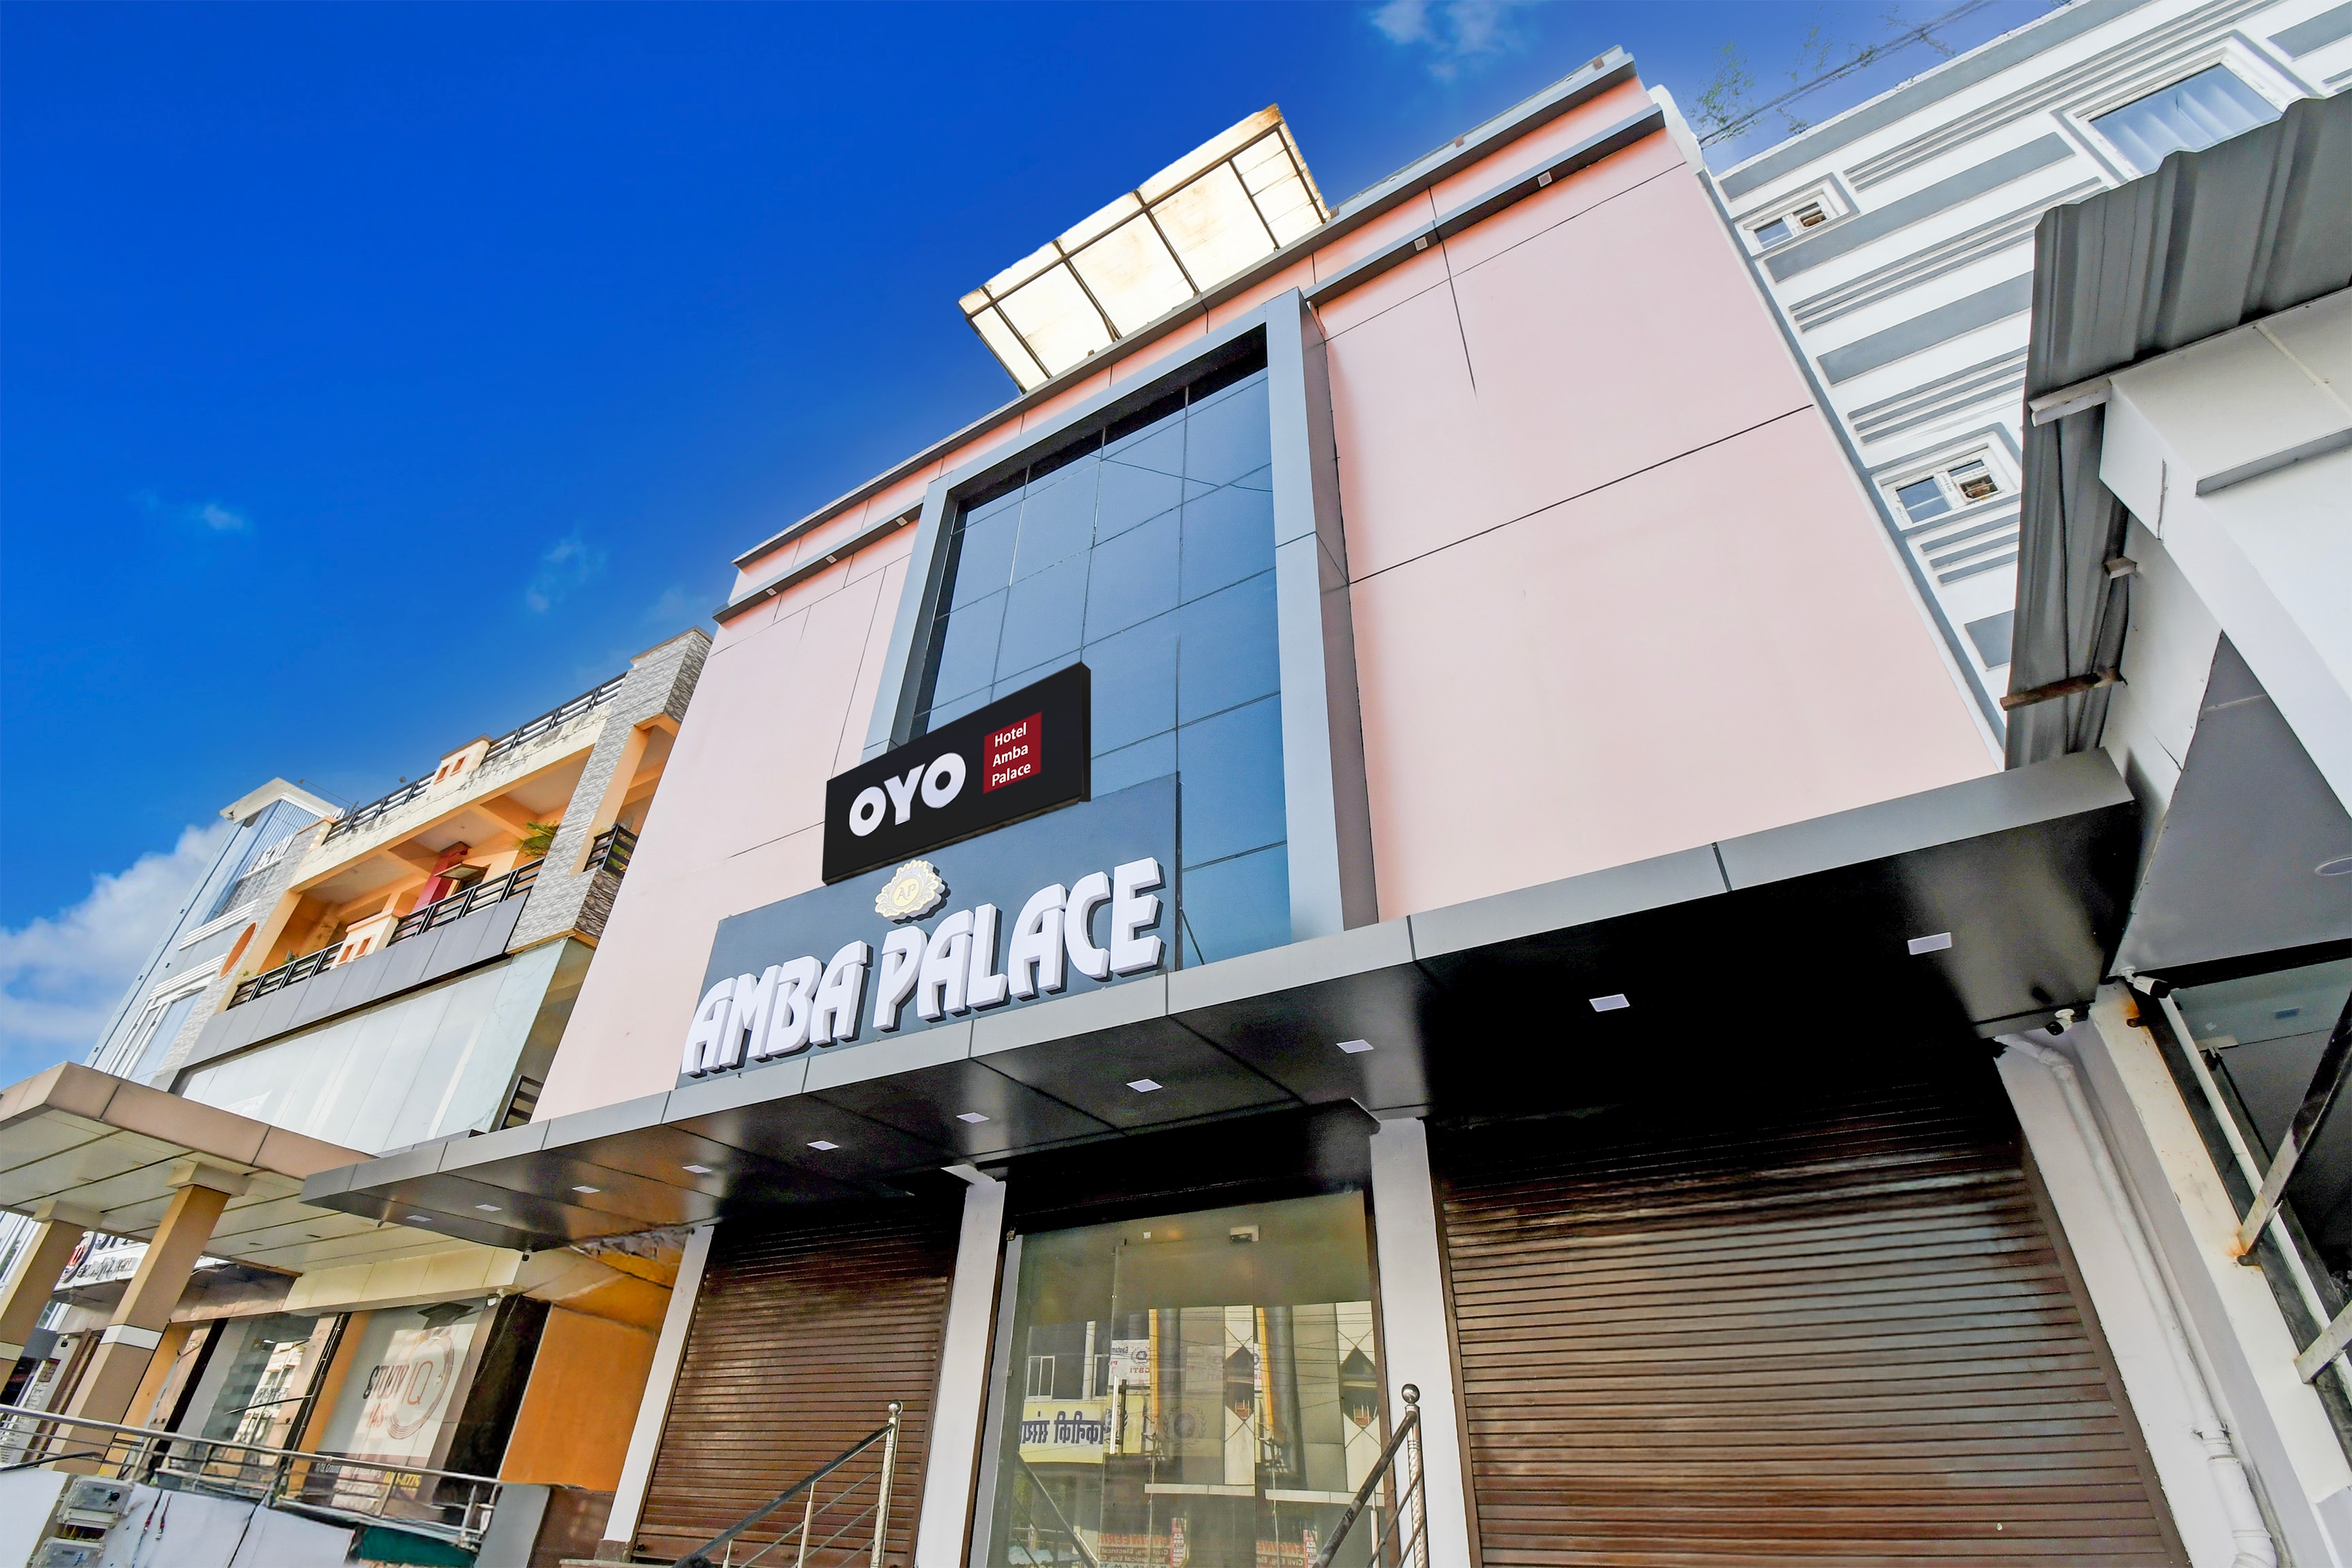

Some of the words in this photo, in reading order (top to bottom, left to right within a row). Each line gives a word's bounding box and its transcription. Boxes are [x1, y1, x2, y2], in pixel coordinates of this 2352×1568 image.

[995, 722, 1026, 747] Hotel
[993, 745, 1028, 767] Amba
[992, 763, 1031, 787] Palace
[849, 753, 966, 836] OYO
[897, 883, 917, 900] AP
[681, 940, 867, 1078] AMBA
[873, 857, 1161, 1032] PALACE
[363, 1365, 410, 1399] STUDY
[402, 1361, 434, 1405] IQ
